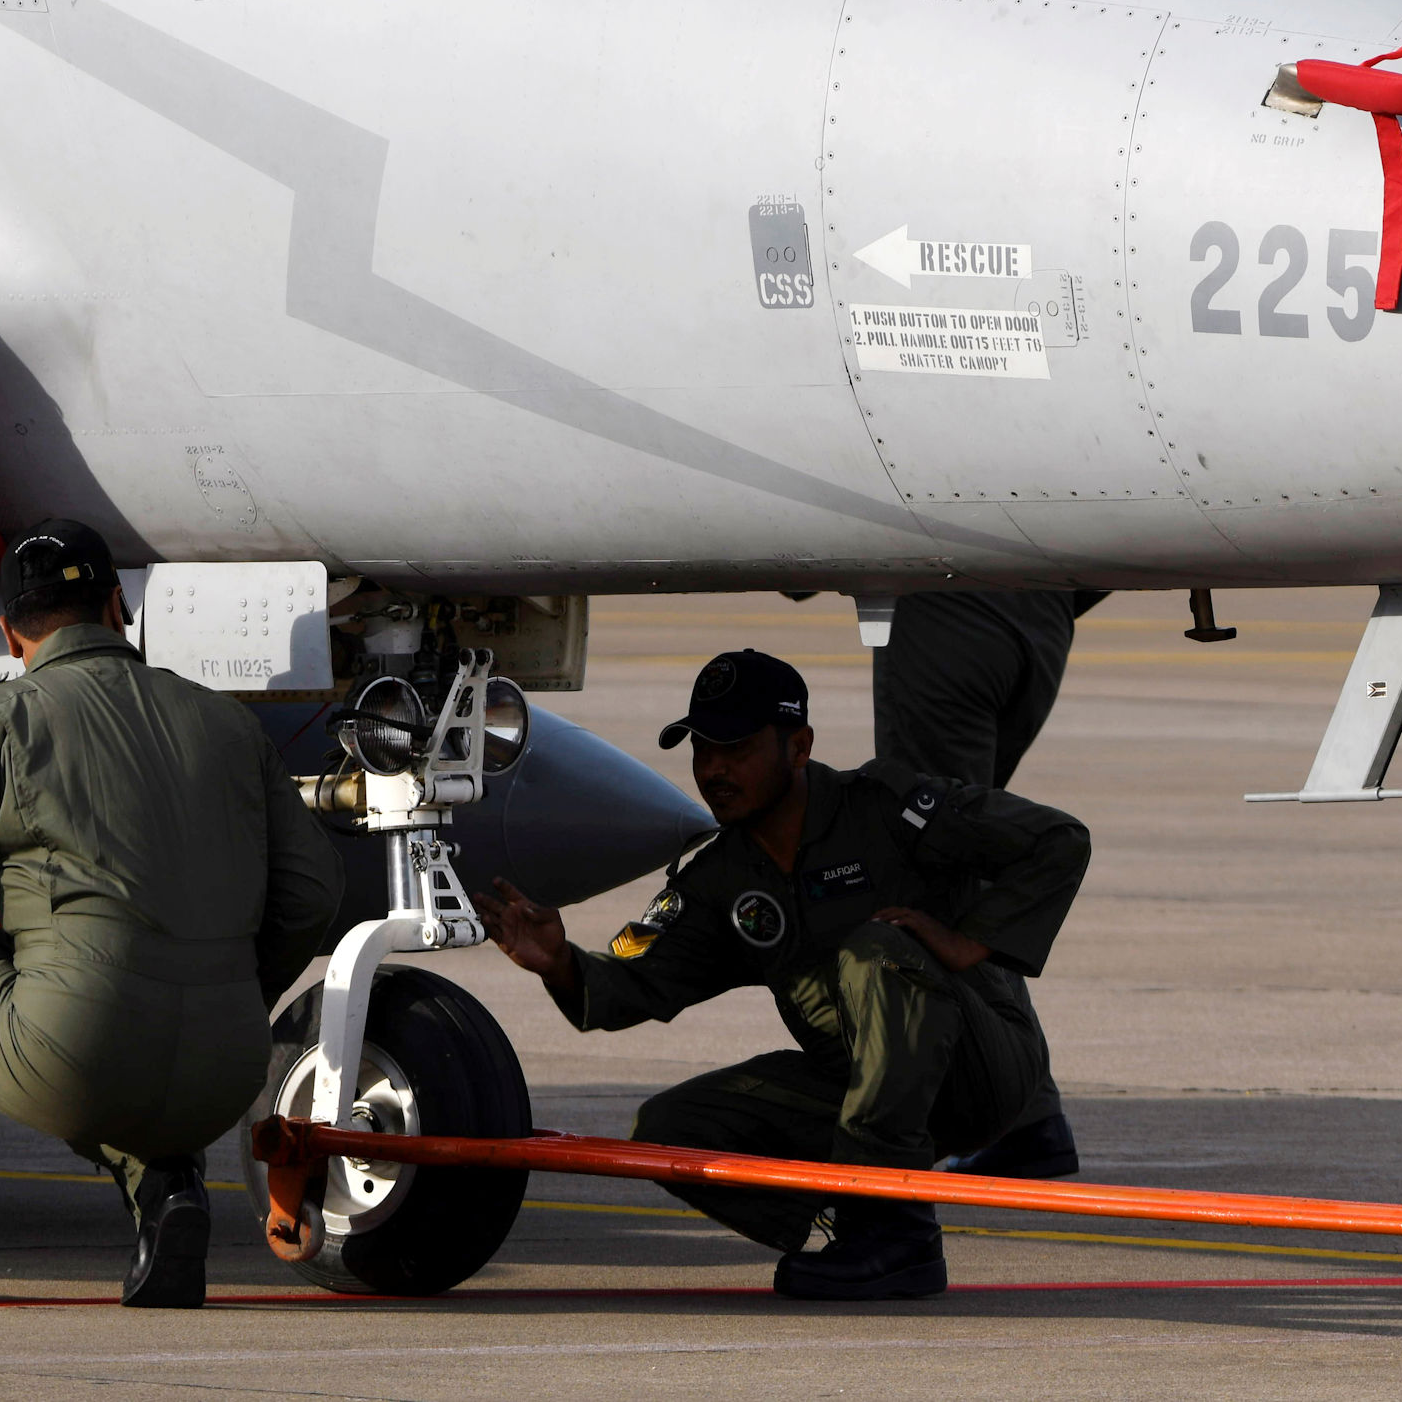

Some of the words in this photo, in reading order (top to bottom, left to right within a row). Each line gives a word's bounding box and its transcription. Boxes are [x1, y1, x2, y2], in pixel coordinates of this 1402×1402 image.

[1225, 15, 1272, 27] 2113-1
[1221, 26, 1268, 37] 2113-1
[1250, 133, 1267, 144] NO
[1273, 135, 1305, 148] GRIP
[757, 193, 797, 206] 2213-1
[759, 203, 800, 216] 2213-1
[920, 241, 1019, 277] RESCUE
[759, 273, 812, 305] CSS
[1189, 220, 1379, 343] 225
[850, 310, 861, 325] 1.
[864, 311, 897, 327] PUSH
[899, 312, 947, 329] BUTTON
[950, 314, 967, 330] TO
[970, 314, 1002, 331] OPEN
[1004, 315, 1039, 333] DOOR
[854, 331, 866, 346] 2.
[867, 332, 898, 347] PULL
[900, 333, 948, 349] HANDLE
[992, 336, 1023, 352] FEET
[1025, 337, 1042, 352] TO
[900, 353, 955, 369] SHATTER
[959, 355, 1008, 372] CANOPY
[200, 659, 220, 678] FC
[227, 659, 275, 678] 10225
[822, 862, 862, 881] ZULFIQAR
